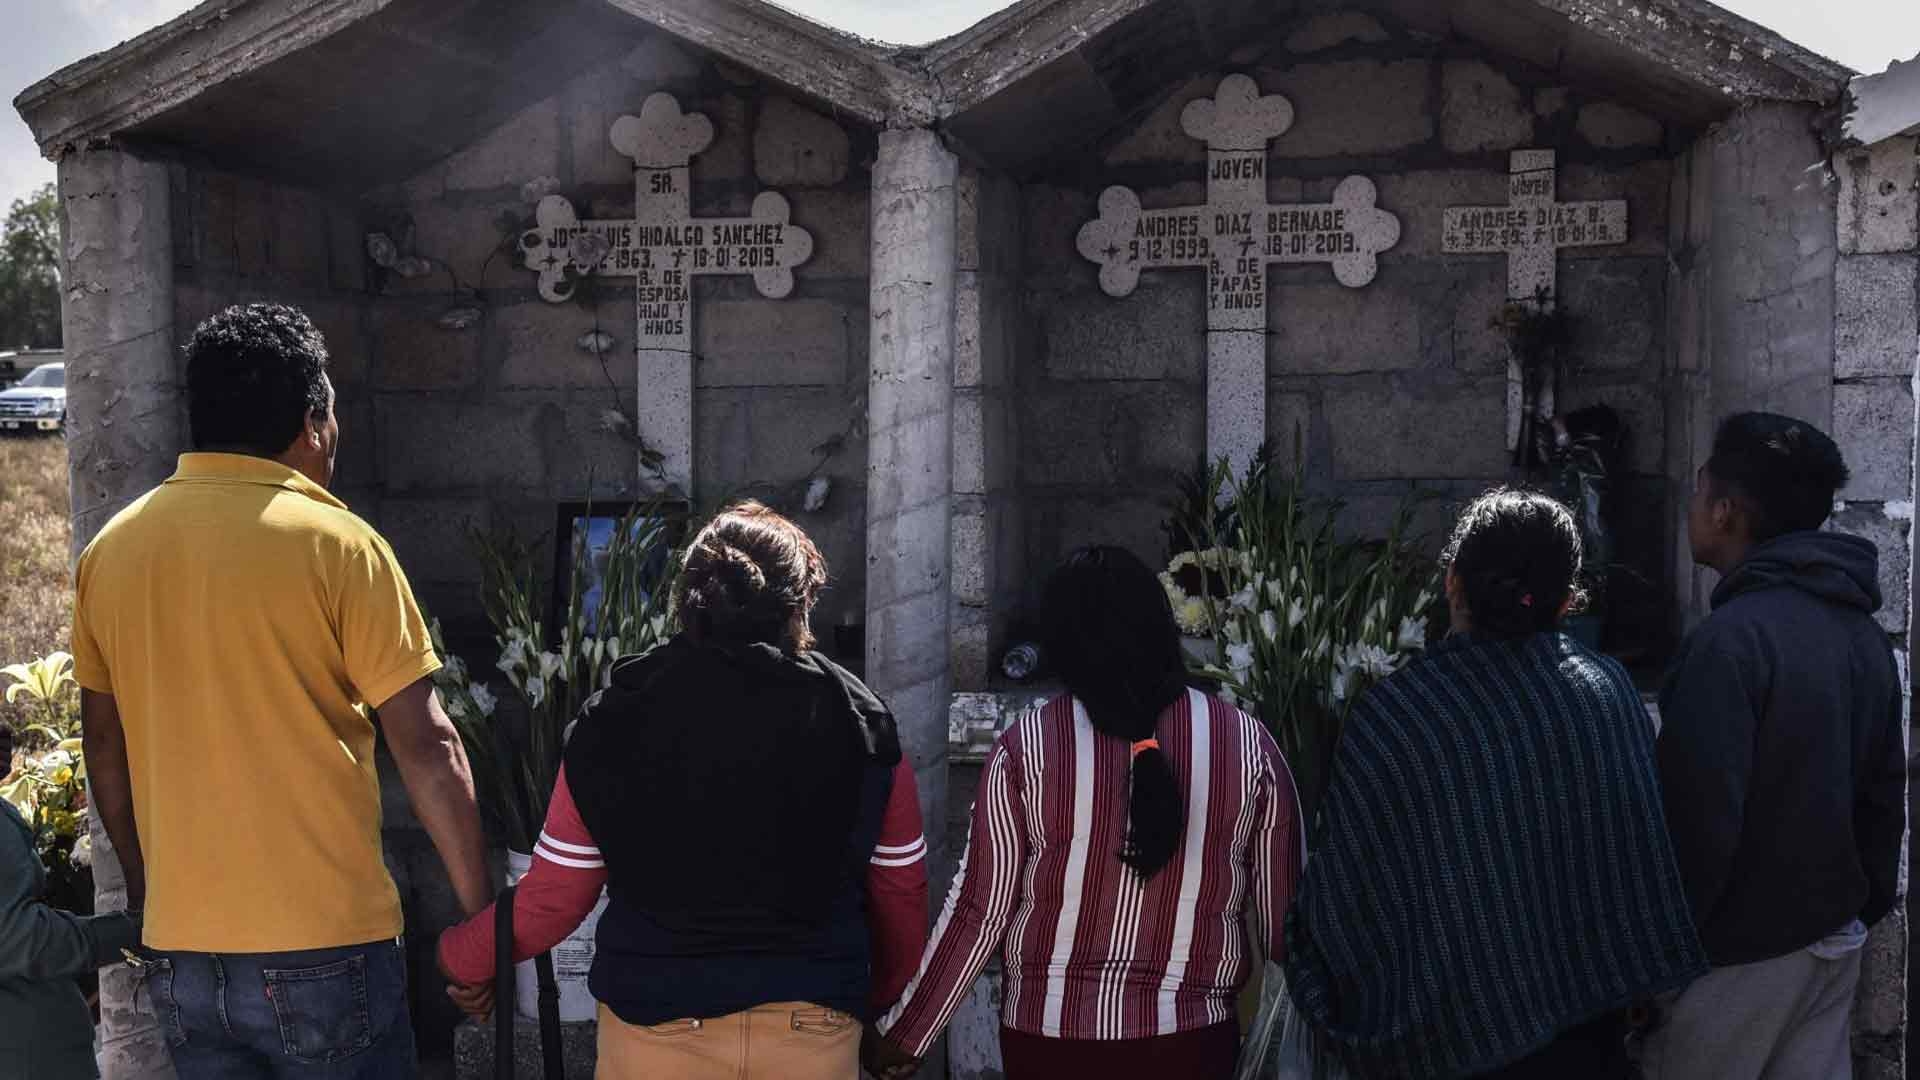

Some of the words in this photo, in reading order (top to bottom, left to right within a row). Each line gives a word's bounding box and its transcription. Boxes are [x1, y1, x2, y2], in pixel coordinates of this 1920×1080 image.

[1211, 157, 1262, 179] JOVEN
[651, 174, 677, 193] SR.
[1135, 214, 1199, 237] ANDRES
[1215, 213, 1252, 235] DIAZ
[1267, 210, 1344, 233] BERNABE
[639, 226, 703, 248] HIDALGO
[713, 223, 784, 246] SANCHEZ
[1210, 259, 1225, 275] R.
[1237, 257, 1259, 273] DE
[639, 269, 654, 286] R.
[663, 269, 682, 286] DE
[1210, 274, 1262, 292] PAPAS
[639, 286, 689, 302] ESPOSA
[1210, 294, 1219, 310] Y
[1224, 292, 1264, 310] HNOS
[640, 303, 669, 319] HIJO
[678, 302, 685, 318] Y
[645, 319, 684, 336] HNOS
